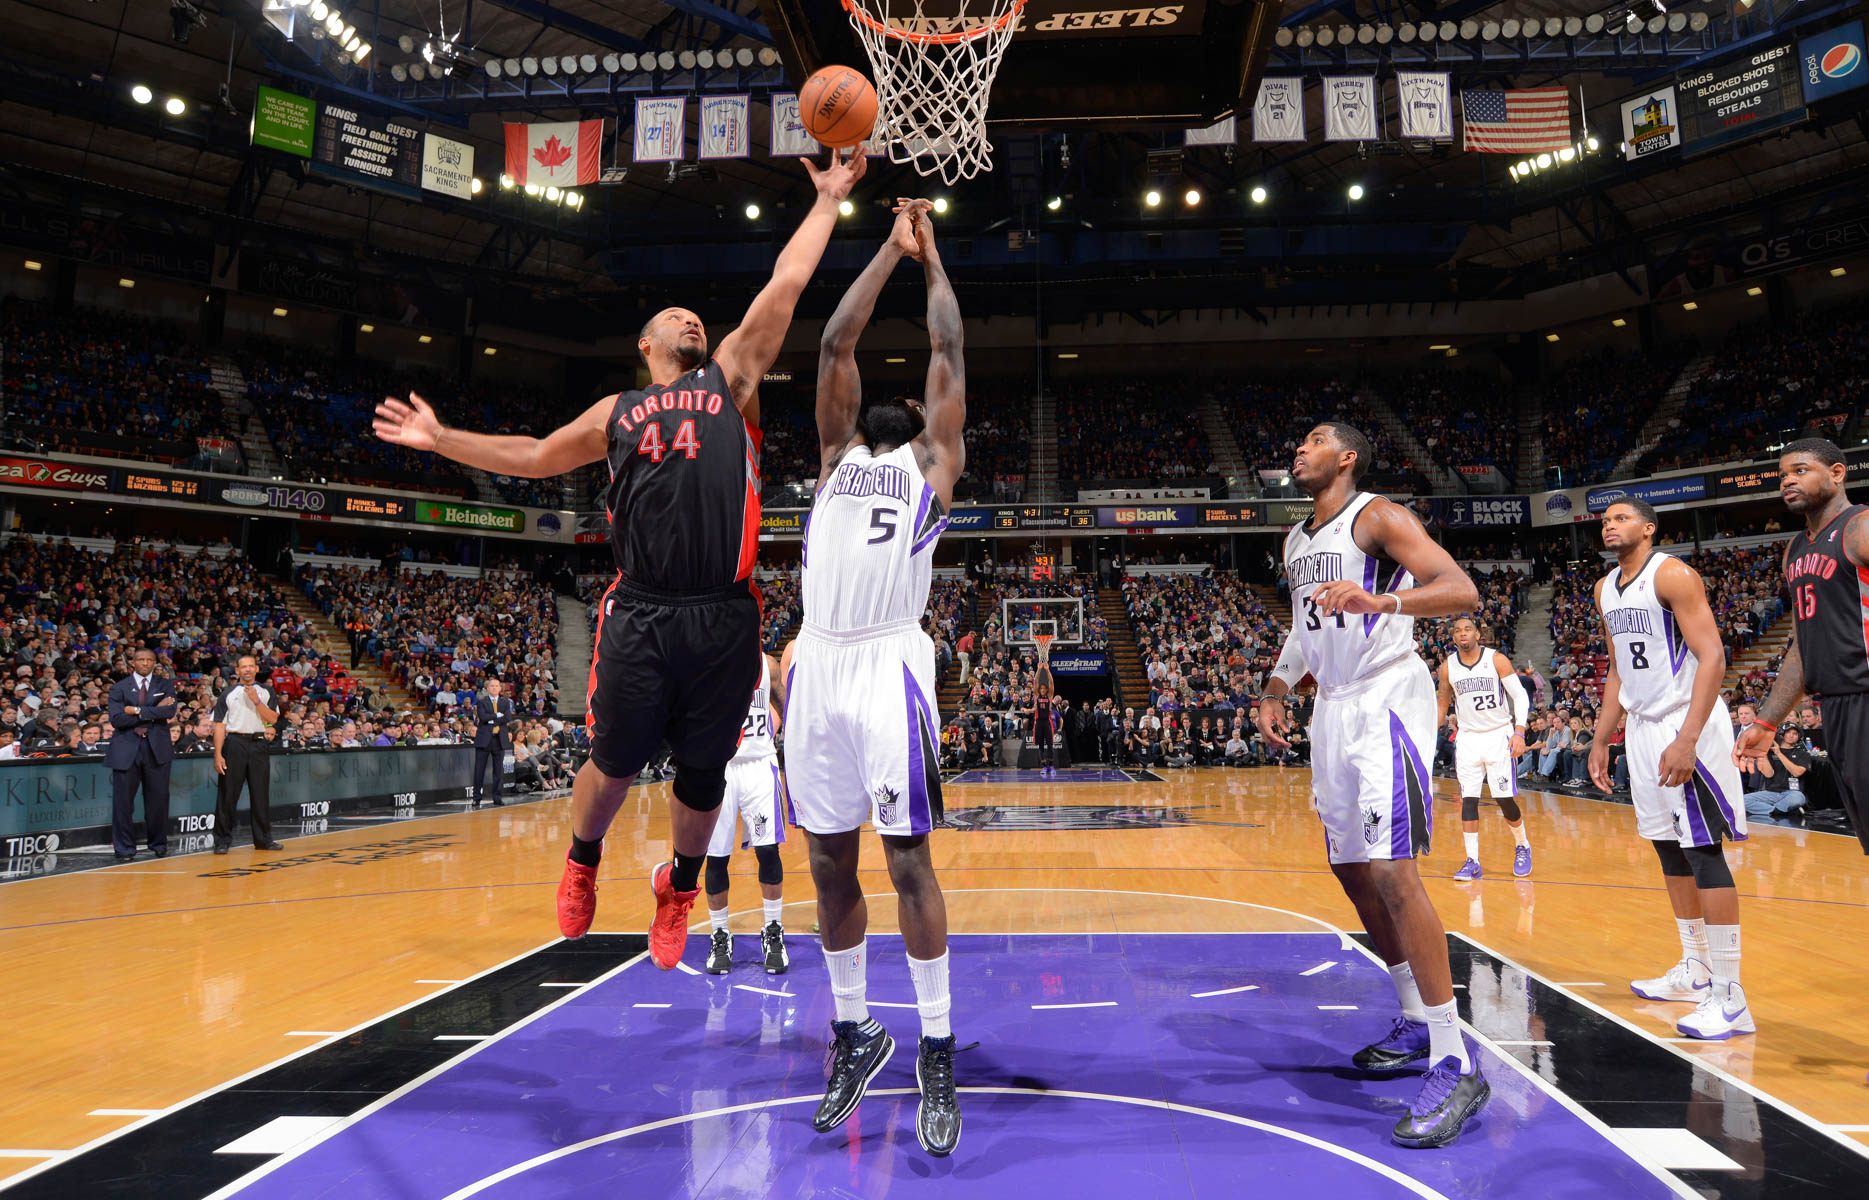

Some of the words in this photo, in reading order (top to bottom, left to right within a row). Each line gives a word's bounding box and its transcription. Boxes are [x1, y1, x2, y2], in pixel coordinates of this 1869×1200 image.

[1034, 5, 1184, 31] SLEEP
[1751, 44, 1791, 66] GUEST
[1804, 54, 1822, 85] pepsi
[1265, 83, 1288, 91] DIVAC
[1333, 81, 1364, 89] WEBBER
[1402, 78, 1425, 88] SIXTH
[1426, 78, 1445, 88] MAN
[1679, 72, 1714, 91] KINGS
[1698, 75, 1741, 98] BLOCKED
[1742, 63, 1775, 83] SHOTS
[818, 72, 858, 120] SPALDING
[1707, 80, 1769, 107] REBOUNDS
[267, 103, 286, 112] YOUR
[277, 99, 294, 109] CARE
[643, 101, 678, 111] TWYMAN
[704, 99, 746, 110] ROBERTSON
[777, 96, 800, 107] ARCH
[1717, 96, 1762, 117] STEALS
[266, 116, 280, 124] AND
[274, 110, 286, 119] THE
[325, 105, 358, 123] KINGS
[1273, 112, 1283, 120] 21
[1348, 111, 1354, 119] 4
[1429, 111, 1434, 119] 6
[1724, 113, 1760, 128] TOTAL
[343, 122, 367, 136] FIELD
[369, 130, 390, 143] GOAL
[386, 123, 418, 140] GUEST
[647, 127, 662, 140] 27
[713, 124, 726, 138] 14
[1637, 139, 1670, 154] CENTER
[1639, 133, 1667, 148] TOWN
[351, 148, 387, 164] ASSISTS
[344, 157, 393, 177] TURNOVERS
[424, 164, 471, 184] SACRAMENTO
[436, 177, 458, 189] KINGS
[1741, 239, 1792, 266] Q's
[763, 373, 792, 381] Drinks
[617, 389, 723, 433] TORONTO
[637, 419, 701, 463] 44
[0, 465, 24, 478] za
[52, 468, 107, 487] Guys
[136, 476, 161, 484] SPURS
[1735, 472, 1778, 483] OUT-OF-TOWN
[133, 483, 168, 492] WIZARDS
[834, 463, 910, 507] CRAMENTO
[1649, 489, 1675, 497] Internet
[1682, 484, 1704, 493] Phone
[1737, 480, 1762, 488] SCORES
[221, 488, 269, 503] SPORTS
[266, 486, 326, 511] 1140
[1472, 501, 1522, 513] BLOCK
[445, 507, 514, 528] Heineken
[759, 516, 793, 527] olden
[793, 515, 800, 527] 1
[948, 516, 982, 524] IGHT
[1002, 518, 1013, 526] 55
[1077, 517, 1089, 525] 36
[1291, 512, 1309, 520] Adva
[1473, 513, 1523, 524] PARTY
[867, 507, 898, 546] 5
[1032, 565, 1052, 580] 24
[1788, 552, 1837, 583] ORONTO
[1795, 583, 1816, 620] 15
[1629, 641, 1650, 670] 8
[1051, 660, 1074, 668] SLEEP
[1454, 676, 1494, 696] SACRAMENTO
[1473, 694, 1497, 711] 23
[744, 714, 766, 737] 22
[393, 792, 416, 807] TIBCO
[29, 808, 70, 825] LUXURY
[74, 806, 111, 819] LIFEST
[301, 801, 330, 817] TIBCO
[178, 814, 216, 833] TIBCO
[6, 833, 60, 857] TIBCO
